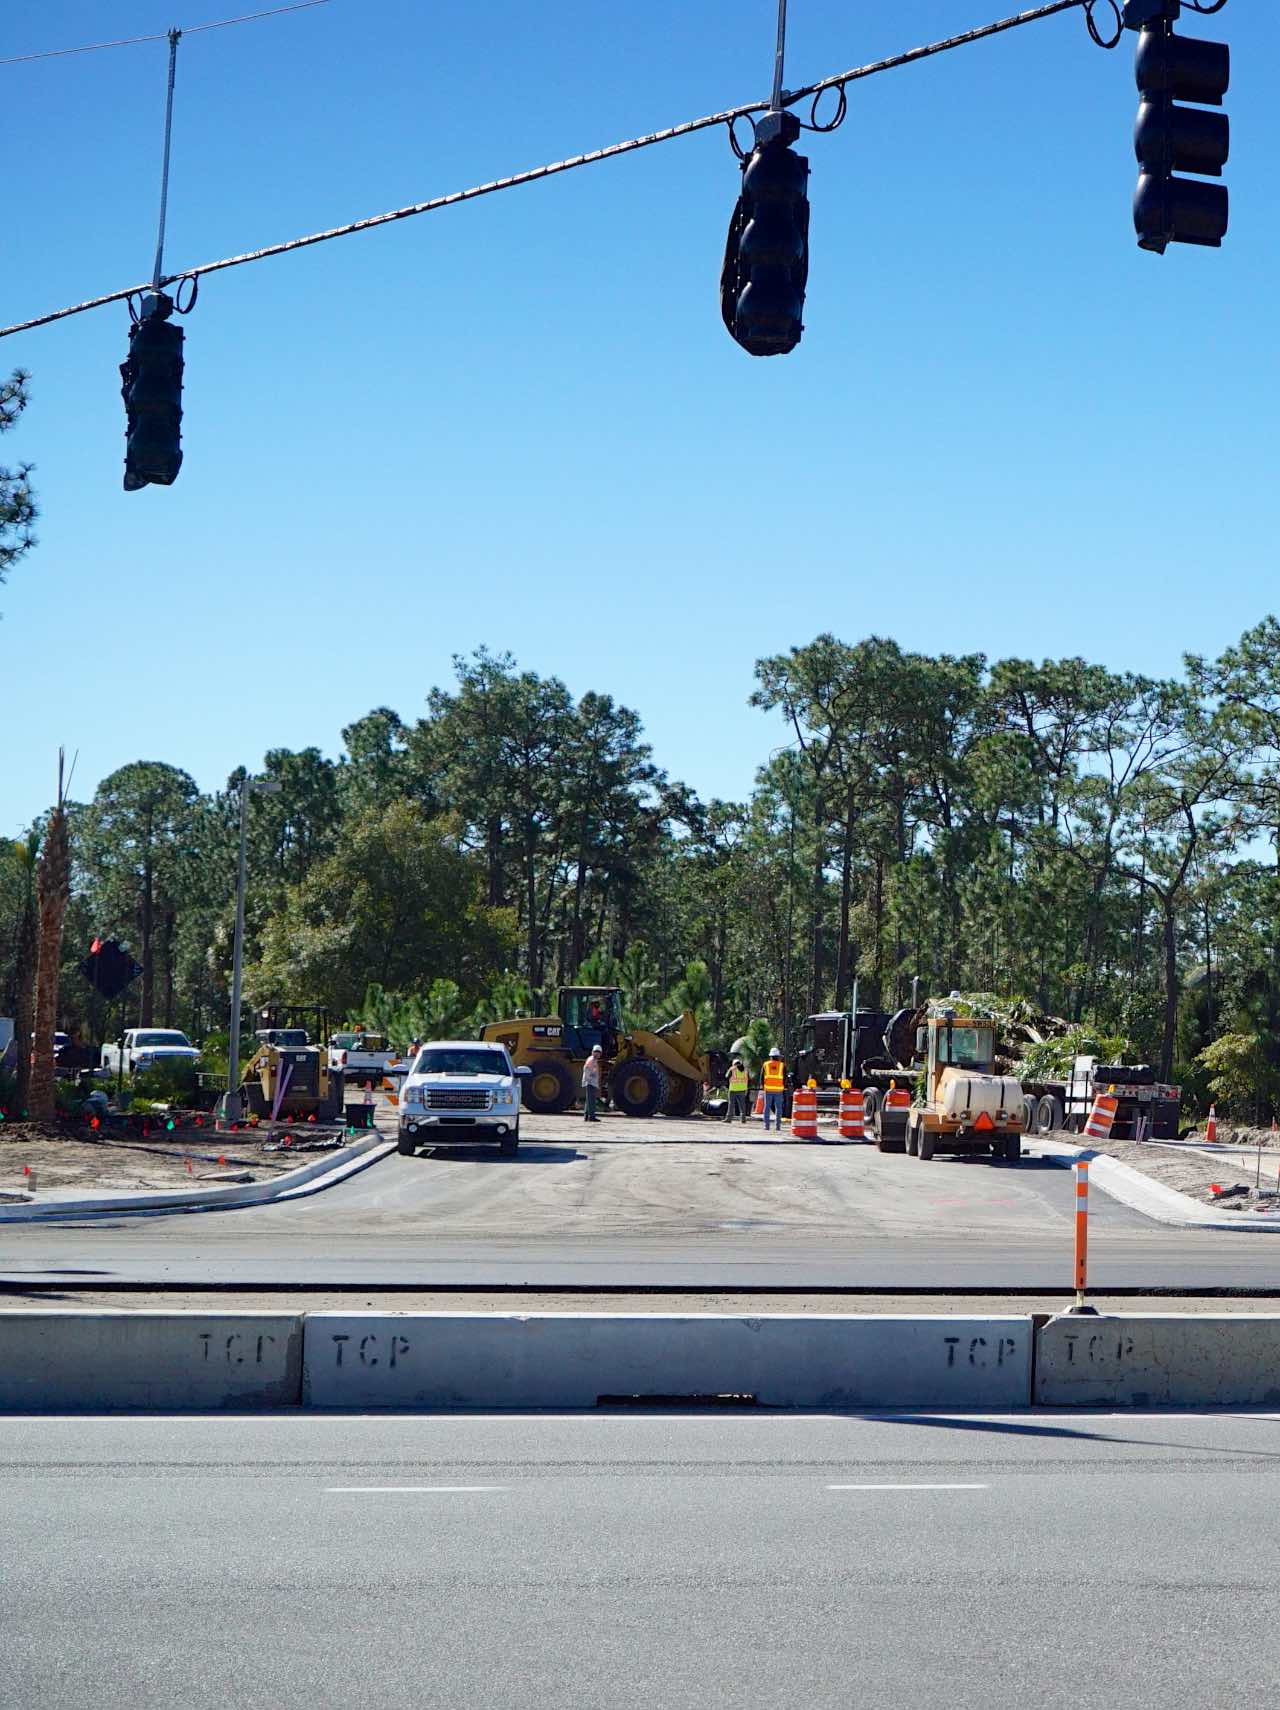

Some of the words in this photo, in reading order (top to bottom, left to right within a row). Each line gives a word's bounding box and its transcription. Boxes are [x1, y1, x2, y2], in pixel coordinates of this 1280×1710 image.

[547, 1026, 561, 1036] CAT
[332, 1334, 410, 1368] TCP
[943, 1337, 1016, 1367] TCP
[1063, 1335, 1134, 1362] TCP
